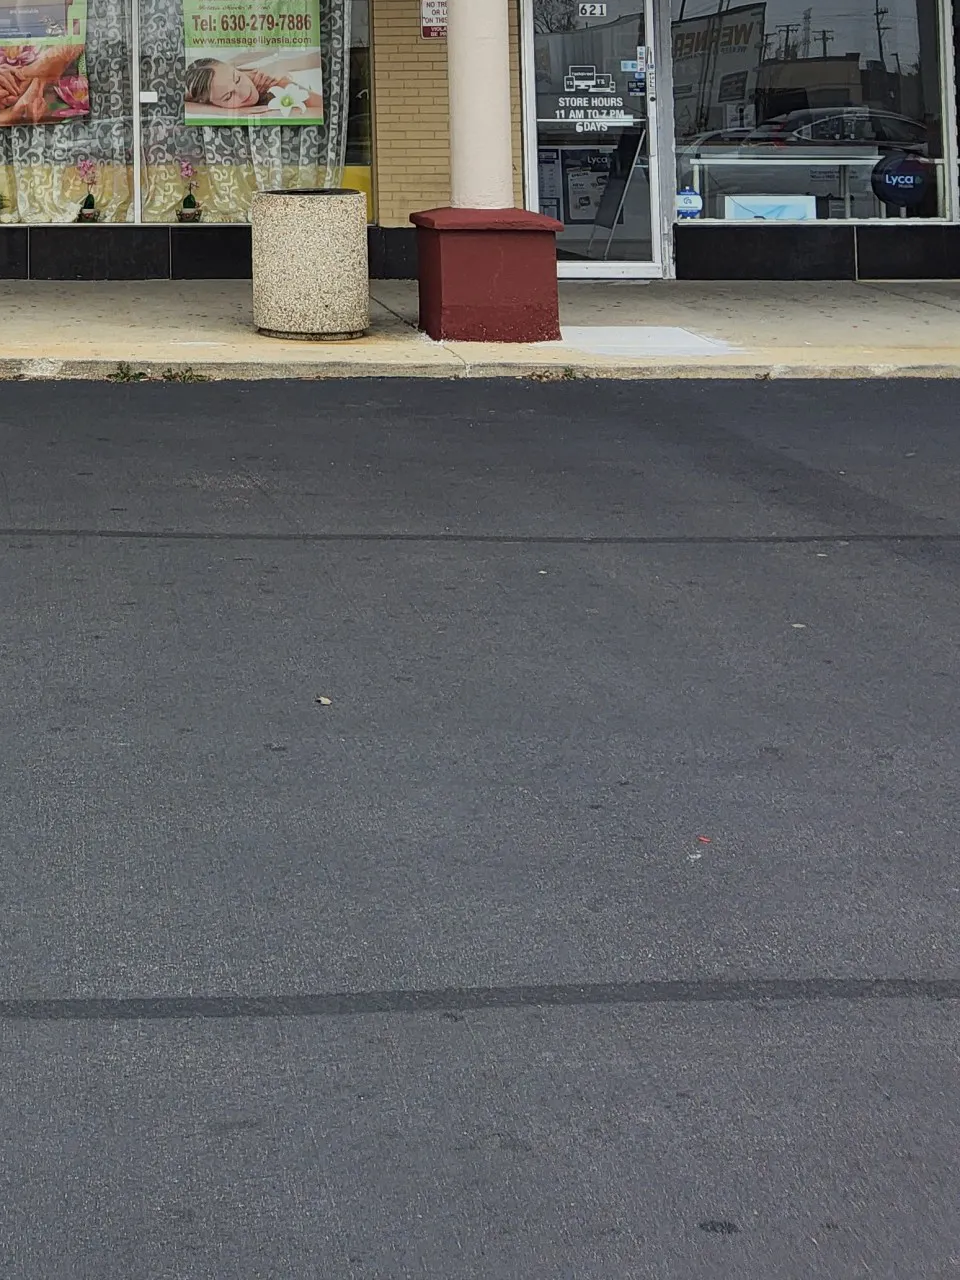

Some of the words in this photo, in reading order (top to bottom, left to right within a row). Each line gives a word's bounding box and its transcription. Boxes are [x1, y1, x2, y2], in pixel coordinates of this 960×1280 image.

[580, 4, 605, 16] 621
[192, 15, 217, 31] Tel:
[220, 14, 312, 31] 630-279-7886
[558, 97, 589, 108] STORE
[591, 97, 624, 107] HOURS
[555, 109, 566, 119] 11
[568, 109, 585, 119] AM
[586, 109, 598, 119] TO
[609, 109, 625, 119] PM
[587, 155, 609, 165] Lyca
[885, 173, 914, 186] Lyca
